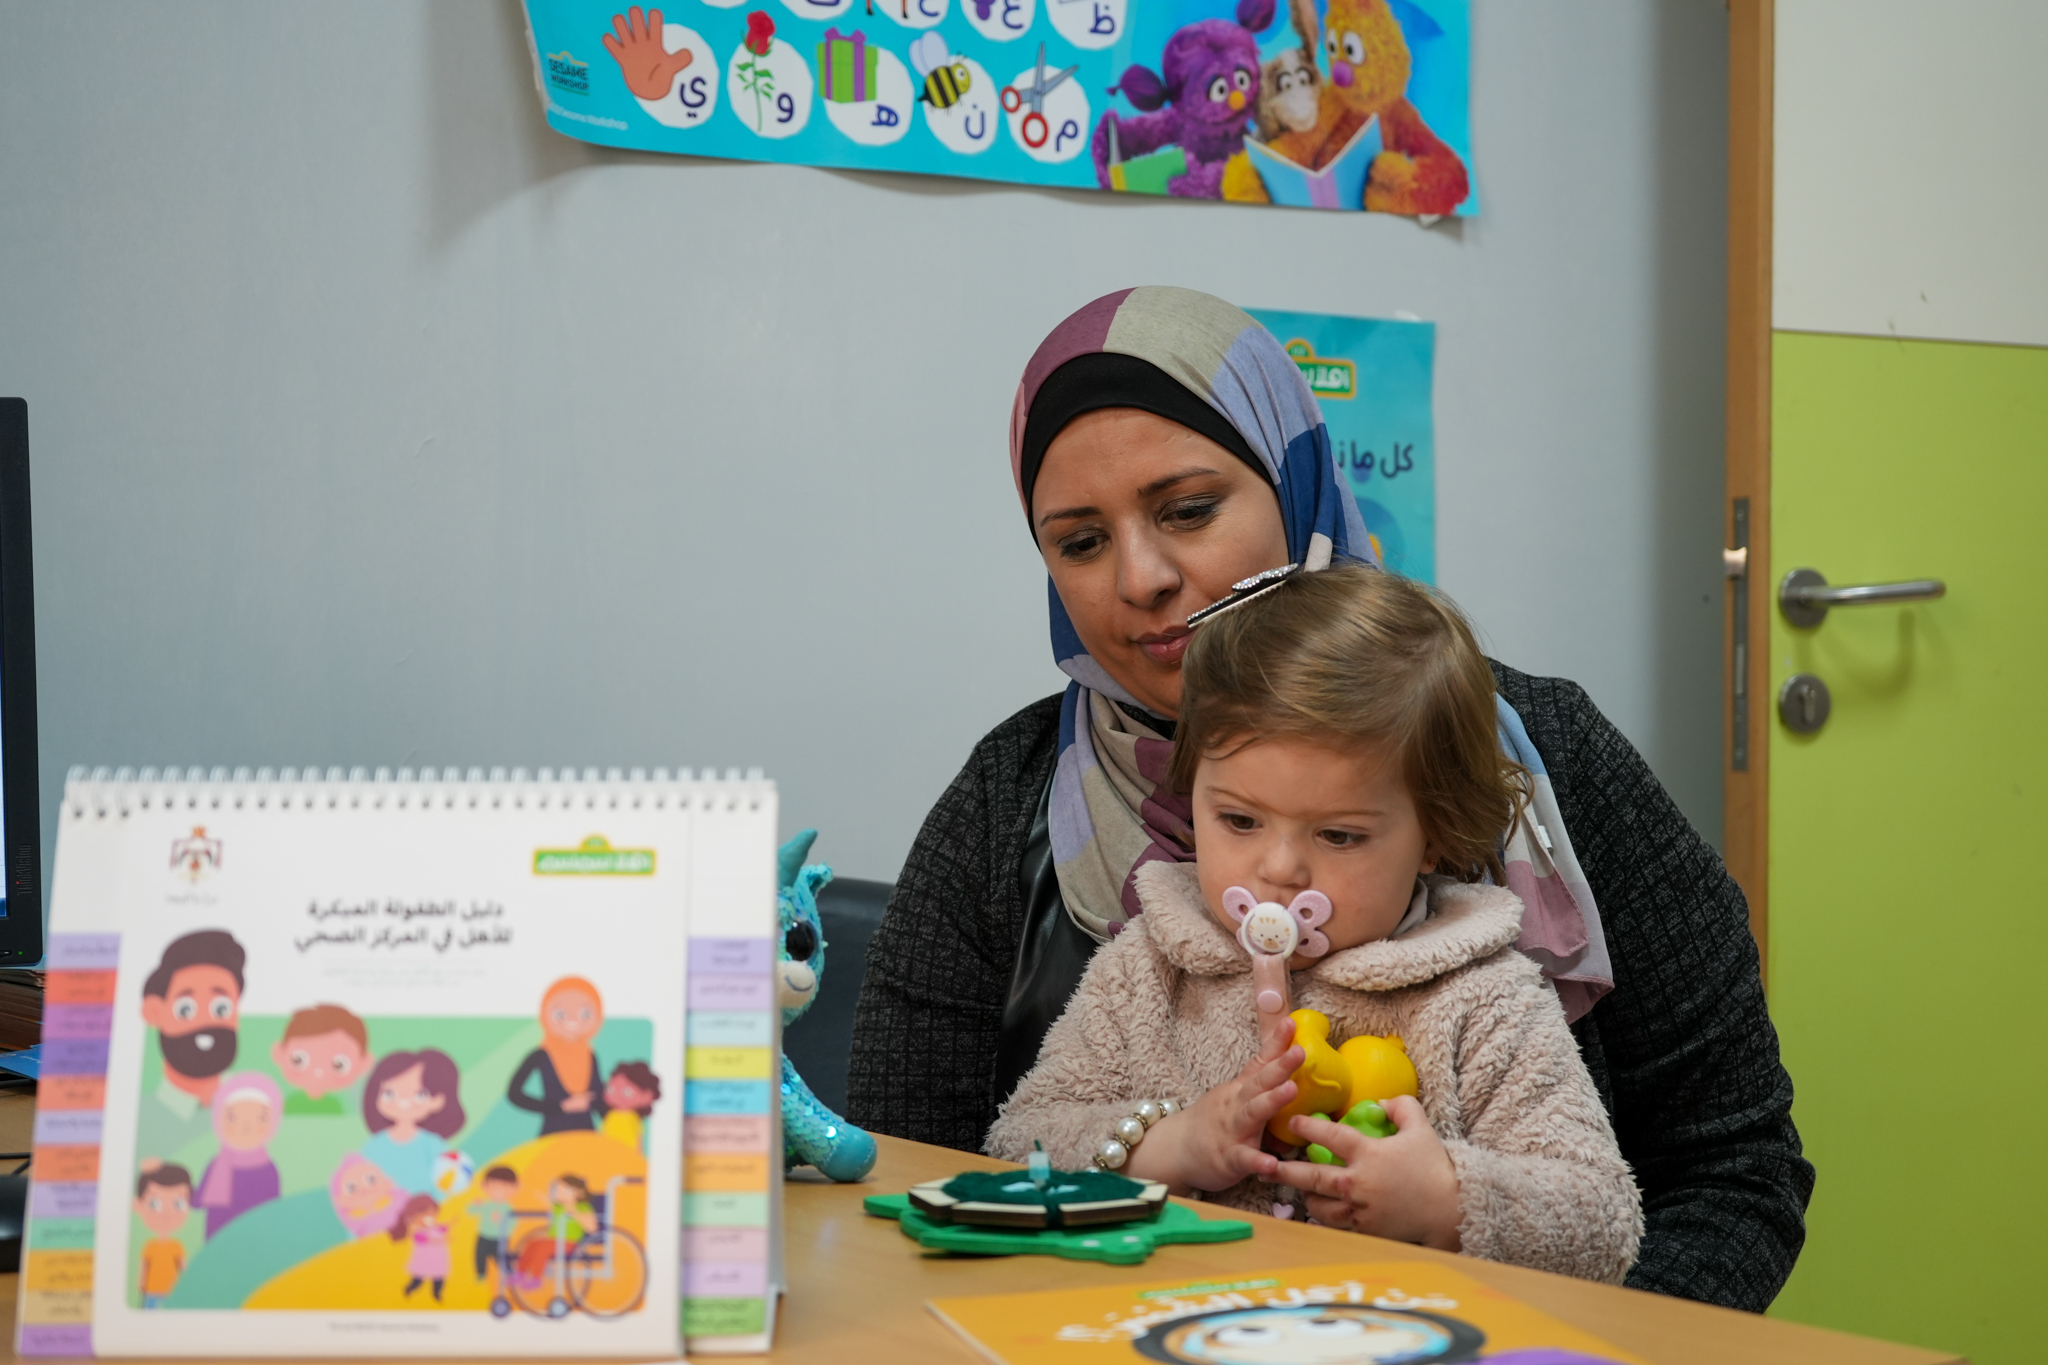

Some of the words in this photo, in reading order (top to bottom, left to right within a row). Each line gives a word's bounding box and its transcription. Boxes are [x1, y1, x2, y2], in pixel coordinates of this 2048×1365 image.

[1089, 2, 1115, 35] ظ
[548, 59, 588, 81] SESAME
[551, 74, 589, 91] WORKSHOP
[679, 76, 708, 119] ي
[776, 92, 795, 124] و
[965, 103, 986, 140] ن
[1056, 119, 1079, 153] م
[1351, 440, 1375, 470] ما
[1380, 442, 1414, 480] كل
[16, 844, 33, 896] ThinkVision
[433, 926, 454, 954] في
